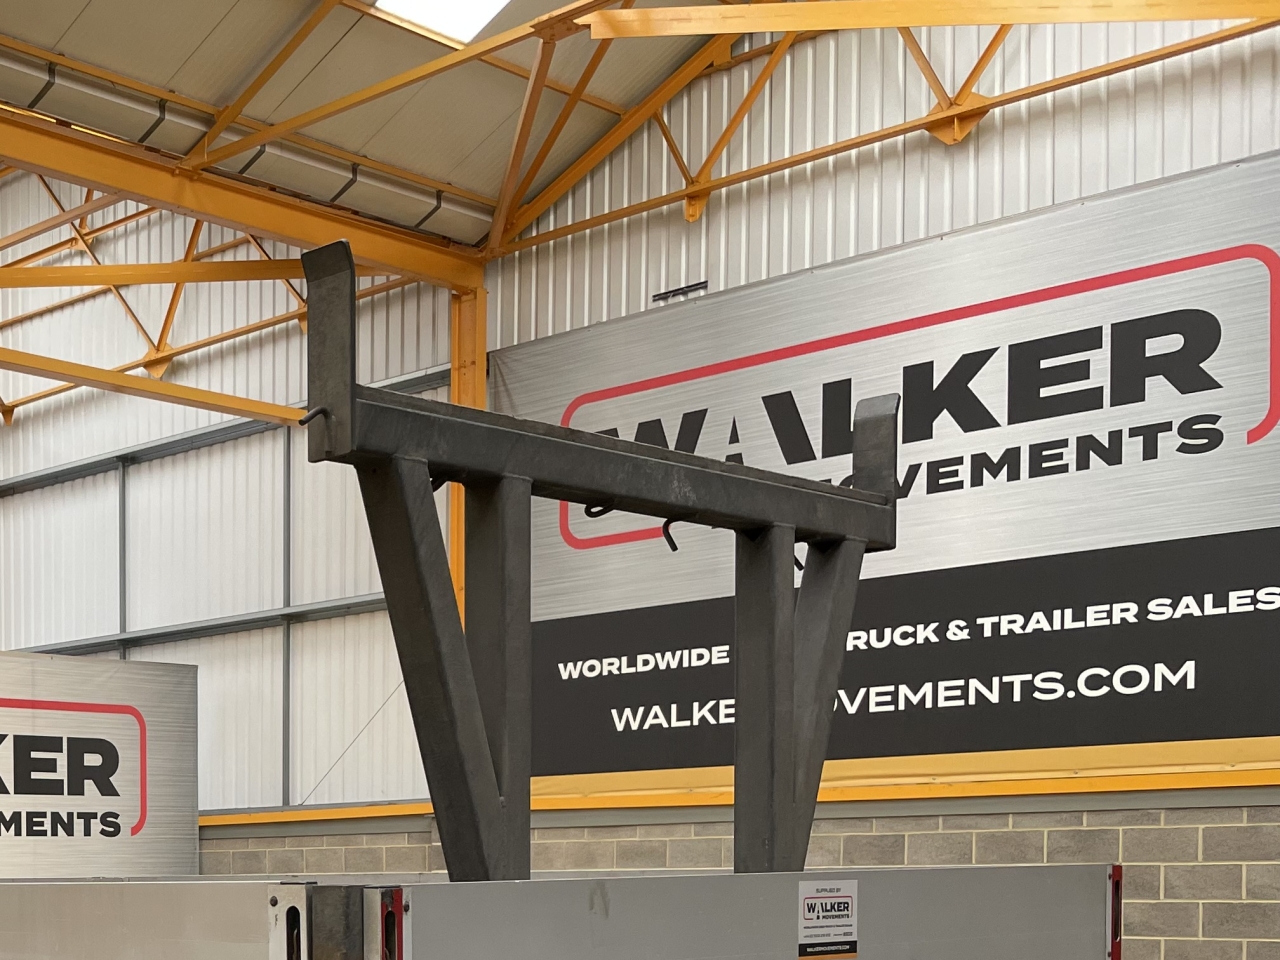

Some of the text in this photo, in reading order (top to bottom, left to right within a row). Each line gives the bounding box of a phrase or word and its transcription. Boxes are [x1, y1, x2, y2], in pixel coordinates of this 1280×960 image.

[557, 586, 1280, 680] WORLDWIDE RUCK & TRAILER SALES
[806, 902, 849, 914] WALKER
